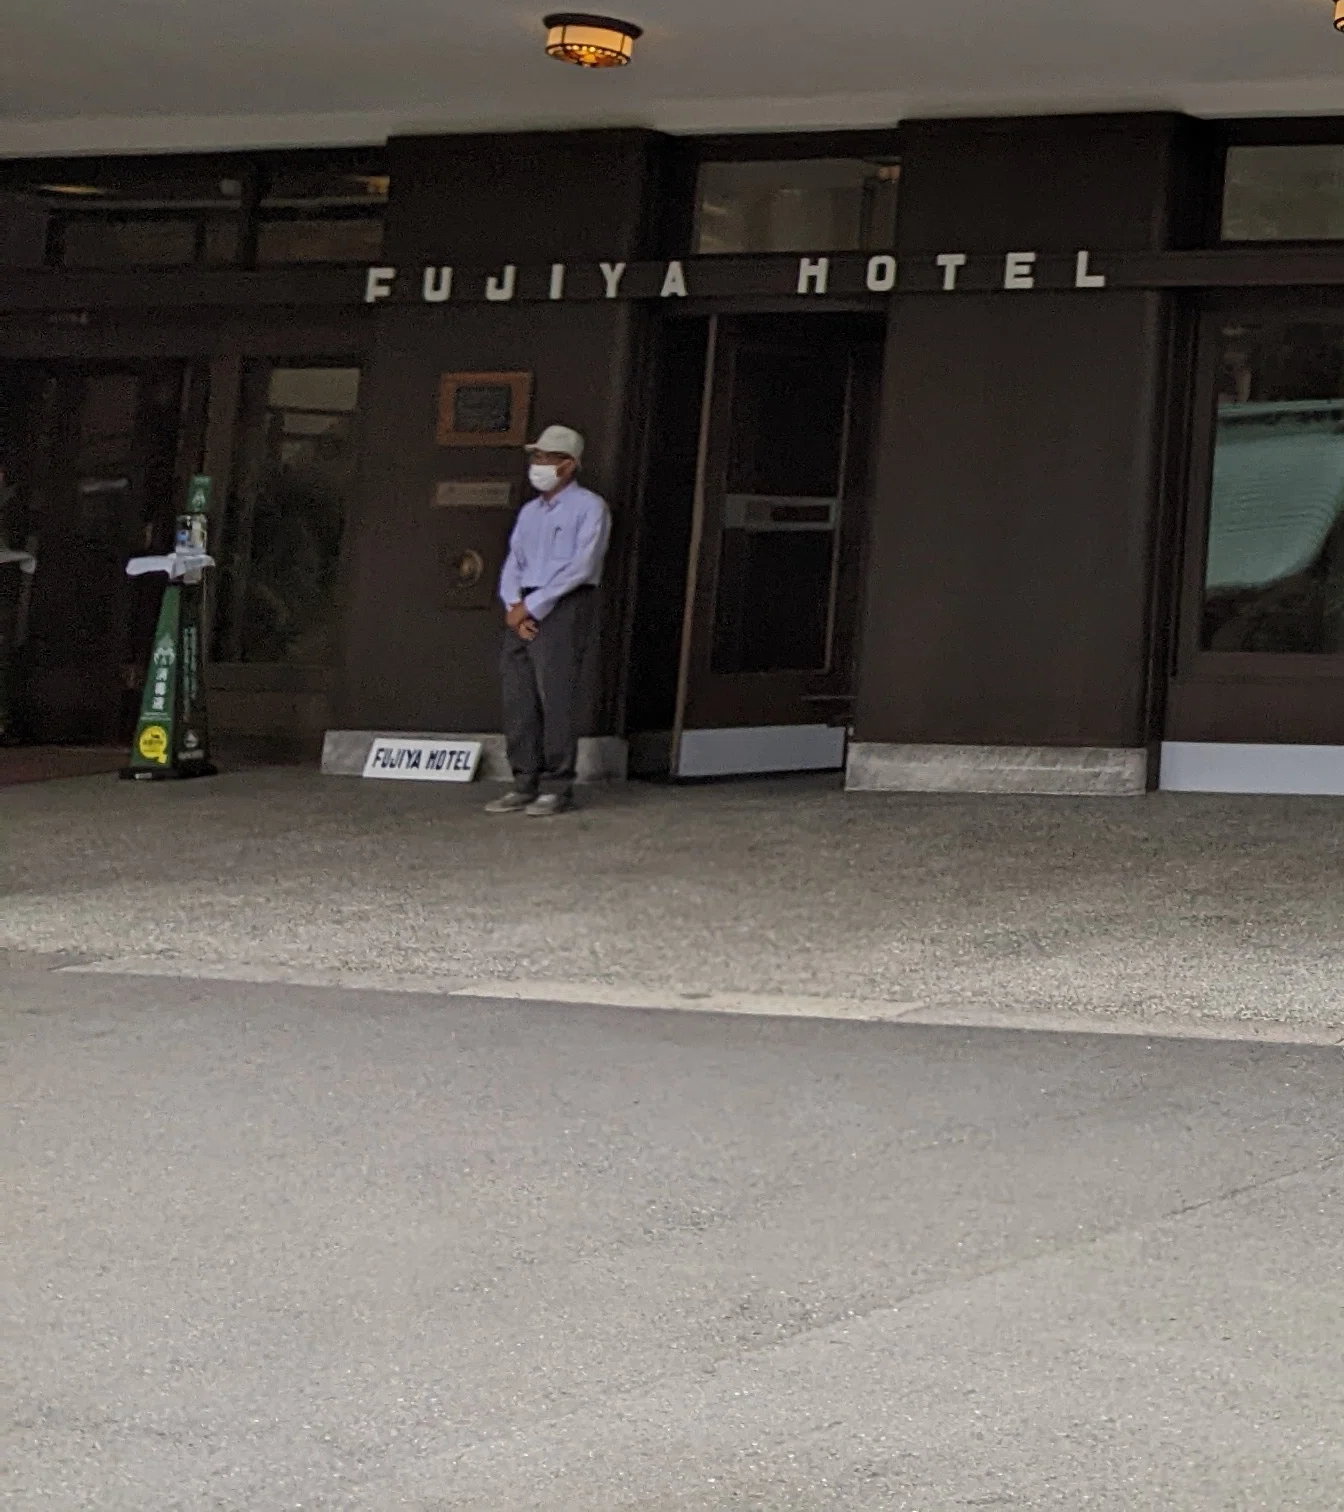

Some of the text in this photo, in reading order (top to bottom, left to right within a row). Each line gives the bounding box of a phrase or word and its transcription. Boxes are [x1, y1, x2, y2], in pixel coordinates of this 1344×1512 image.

[364, 251, 1106, 303] FUJIYA HOTEL
[372, 748, 471, 770] FUJIYA HOTEL
